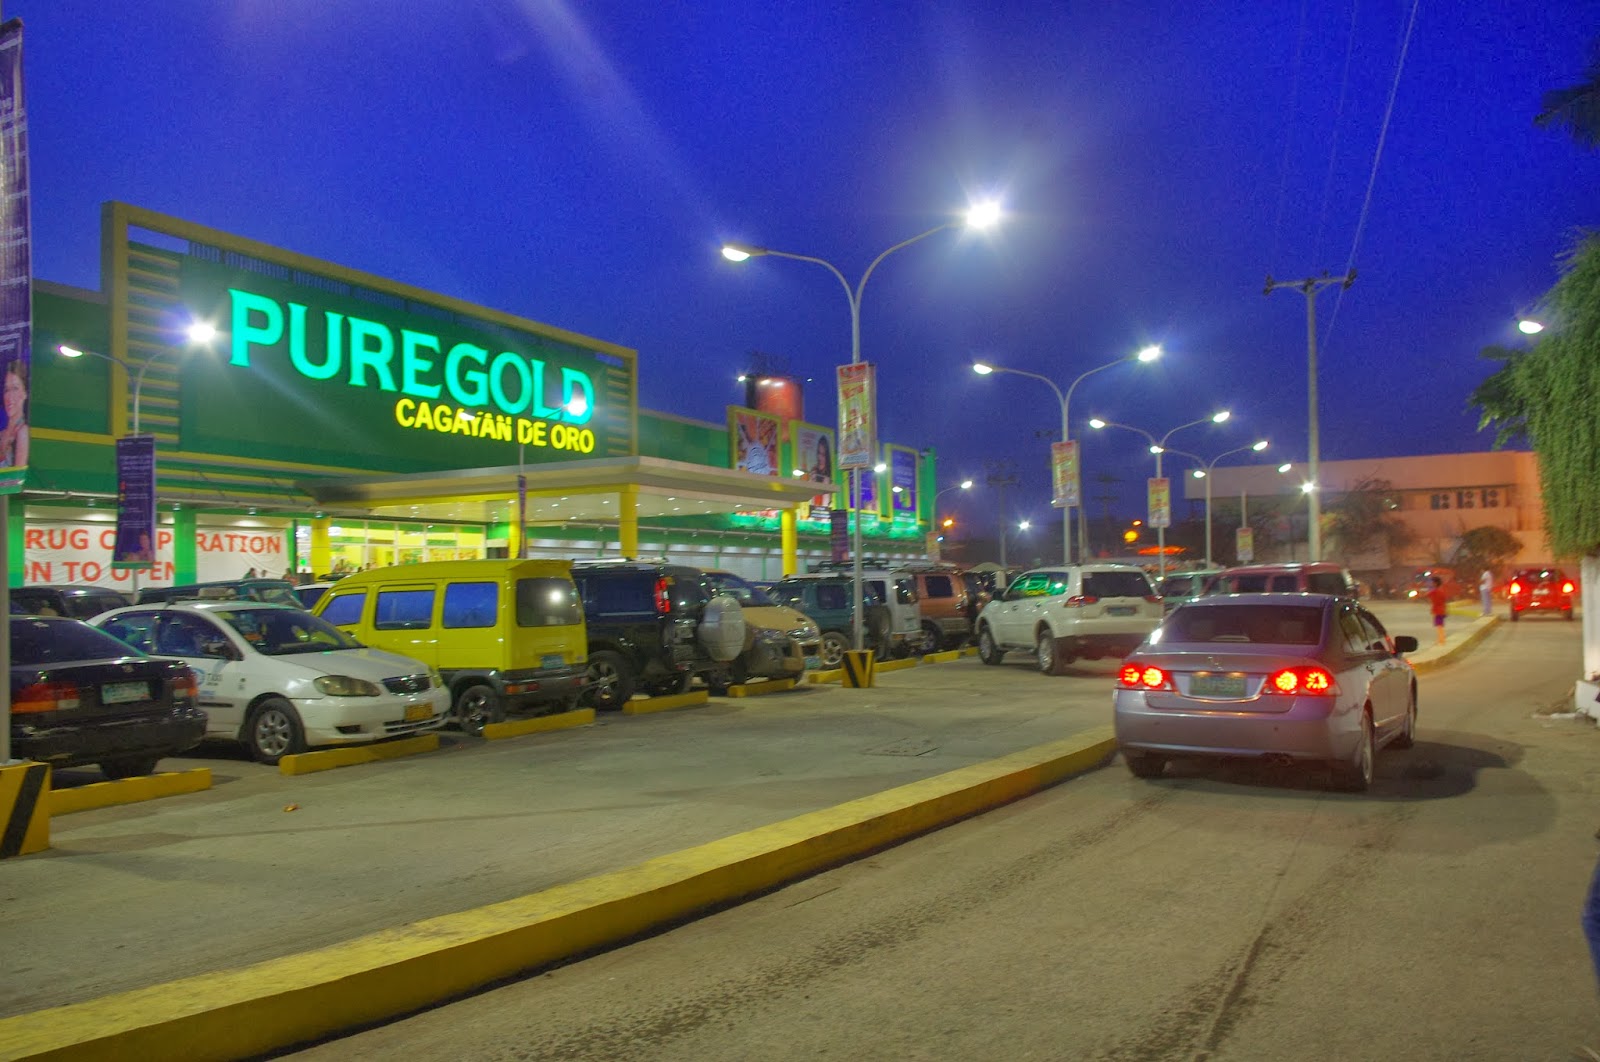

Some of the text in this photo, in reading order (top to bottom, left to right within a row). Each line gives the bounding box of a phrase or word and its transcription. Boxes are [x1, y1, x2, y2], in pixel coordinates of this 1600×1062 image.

[229, 288, 595, 425] PUREGOLD
[395, 398, 595, 454] CAGAYAN DE ORO
[62, 561, 102, 582] TO
